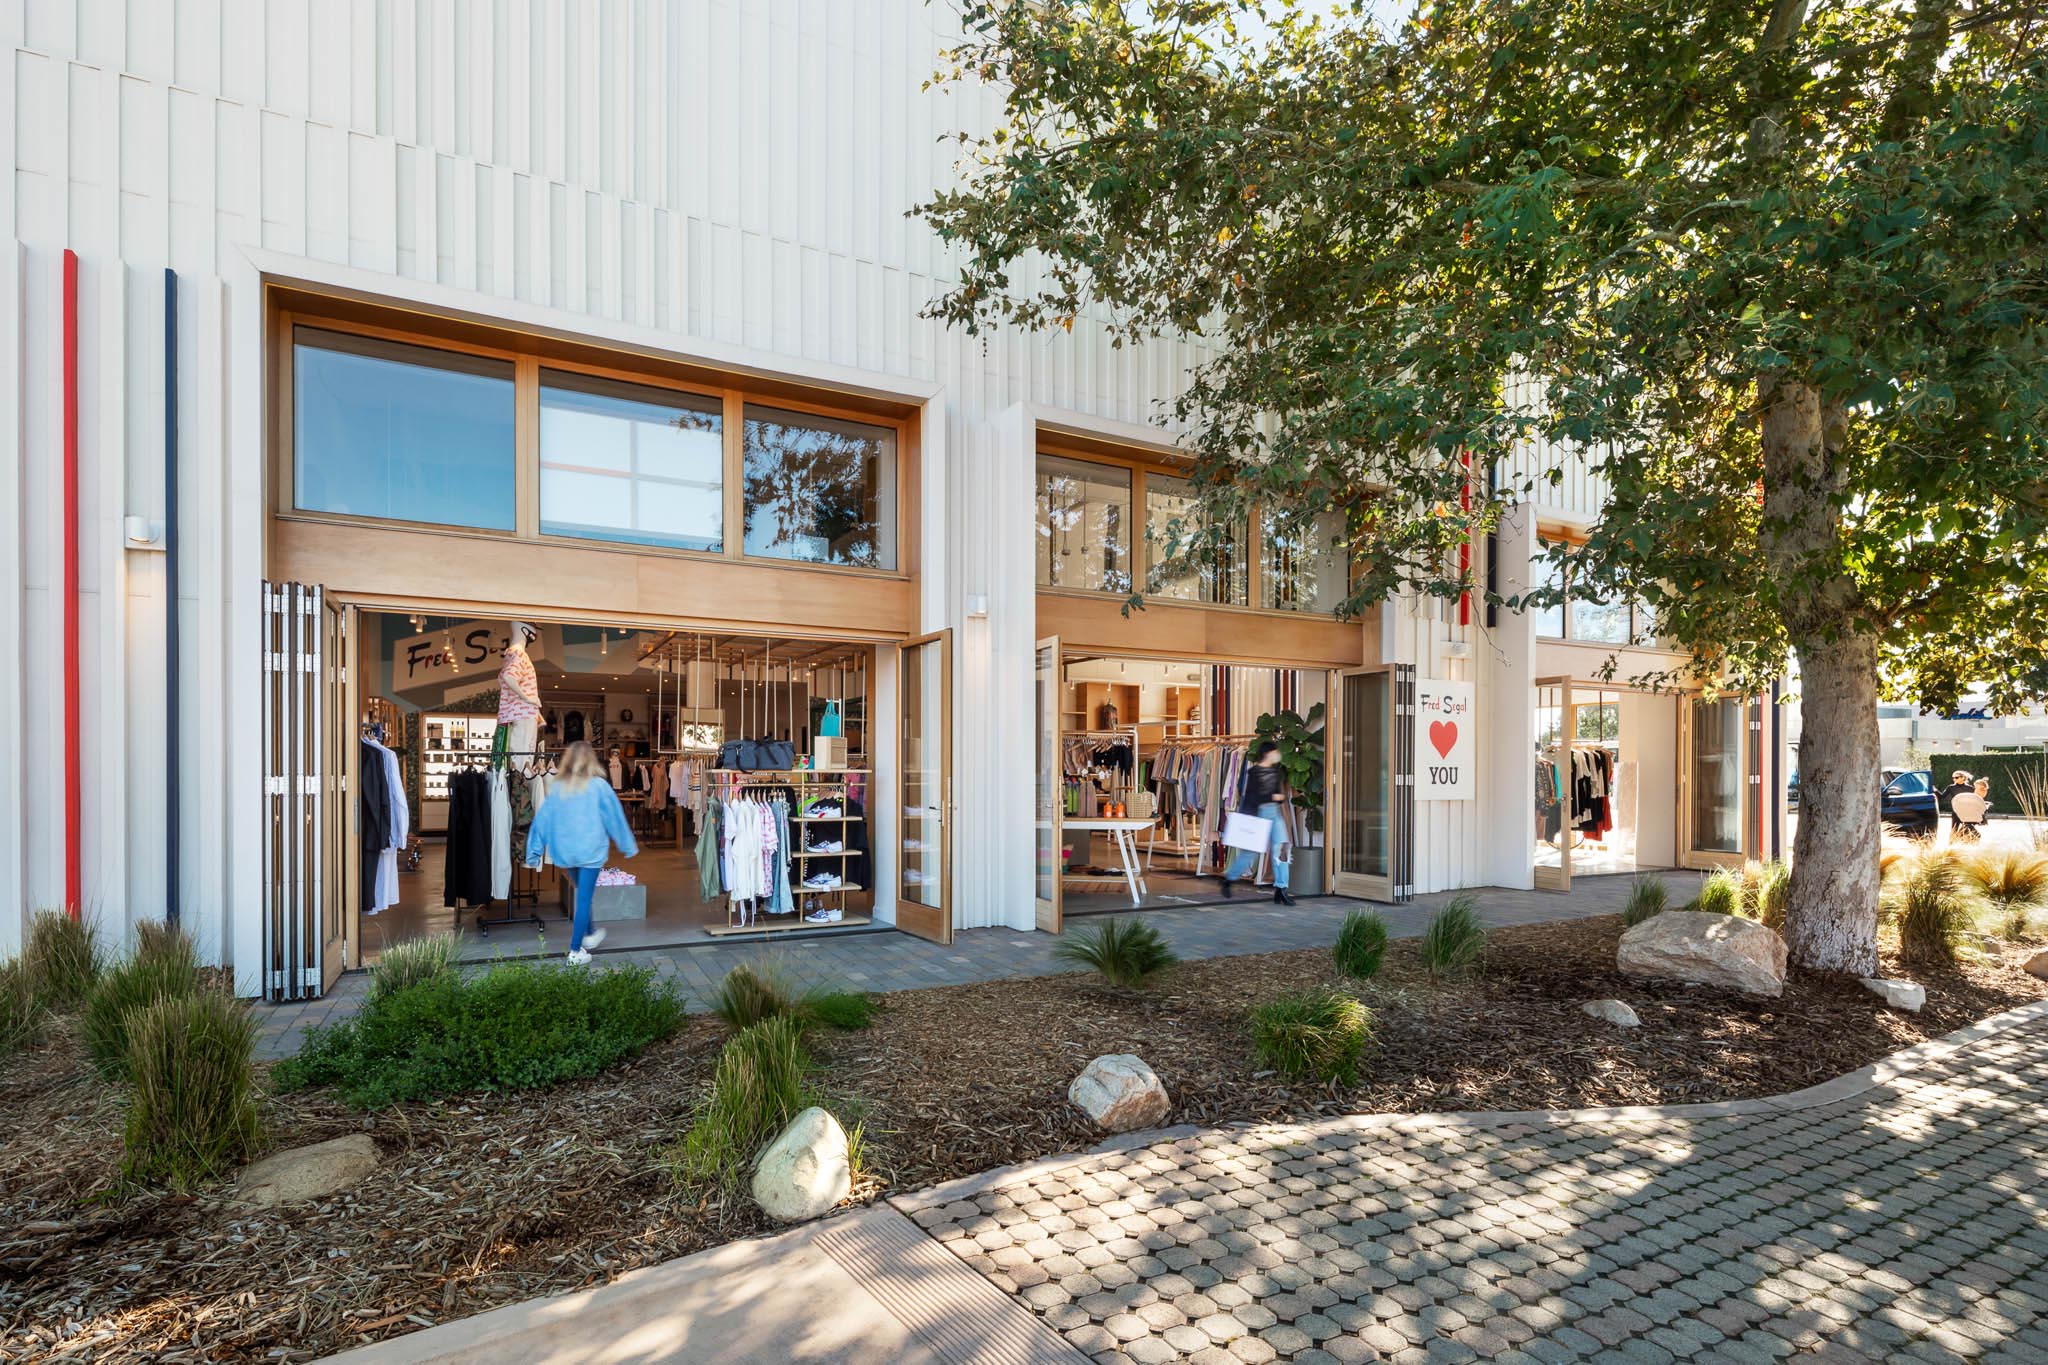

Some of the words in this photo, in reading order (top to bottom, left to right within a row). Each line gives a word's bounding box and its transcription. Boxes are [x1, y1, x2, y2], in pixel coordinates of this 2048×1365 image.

[1420, 694, 1440, 712] Fred
[1443, 695, 1467, 714] Segal
[1429, 766, 1459, 785] YOU
